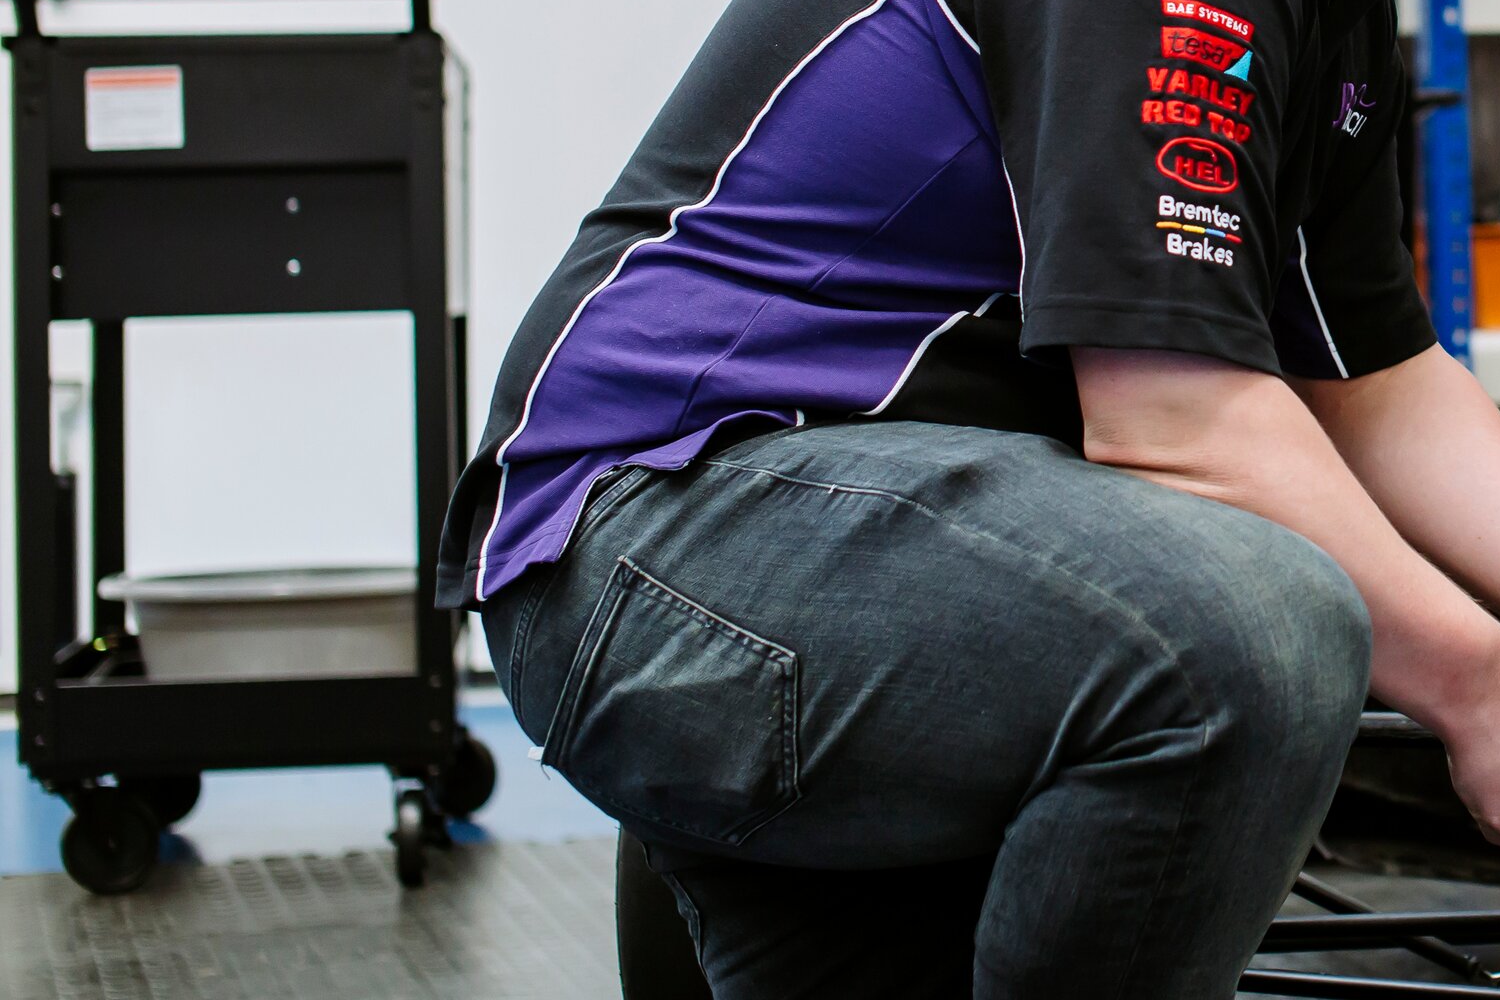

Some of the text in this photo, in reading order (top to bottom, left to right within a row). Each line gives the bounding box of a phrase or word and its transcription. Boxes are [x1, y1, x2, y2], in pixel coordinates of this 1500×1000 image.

[1166, 2, 1249, 36] BAE SYSTEMS
[1167, 31, 1225, 65] tesa
[1146, 67, 1255, 116] VARLEY
[1142, 99, 1251, 144] RED TOP
[1175, 156, 1231, 186] HEL
[1159, 195, 1241, 231] Bremtec
[1167, 232, 1234, 267] Brakes
